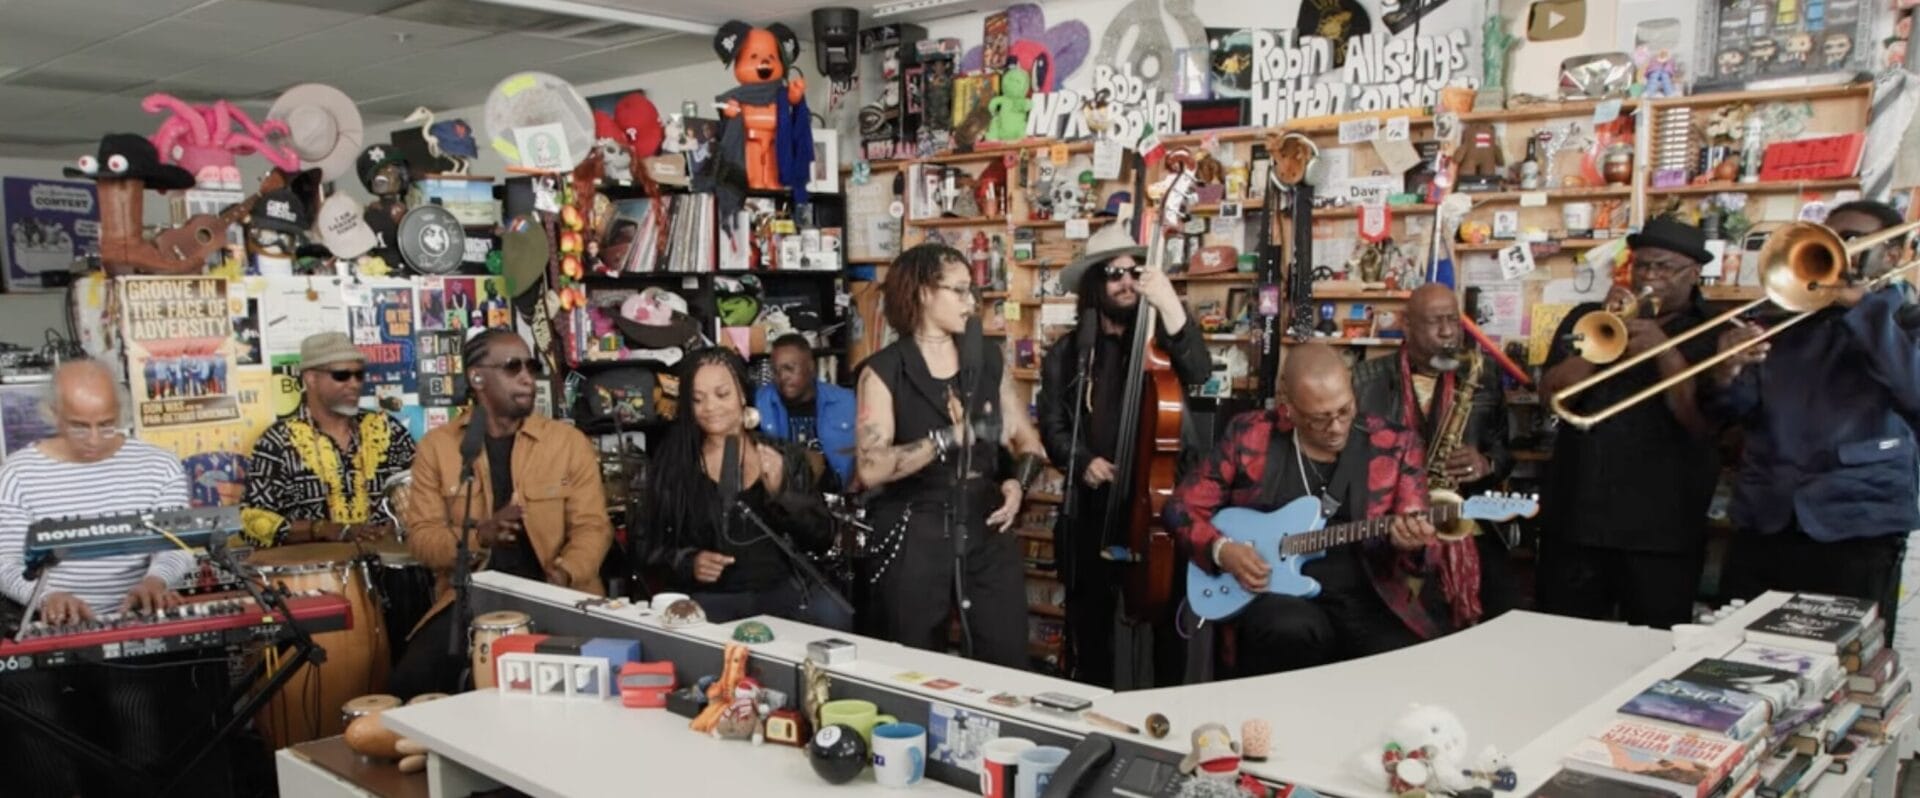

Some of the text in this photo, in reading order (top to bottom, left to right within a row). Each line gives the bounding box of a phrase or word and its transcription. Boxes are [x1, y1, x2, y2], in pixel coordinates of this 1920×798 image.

[1252, 29, 1330, 82] Robin
[1096, 63, 1142, 104] Bob
[1252, 78, 1346, 127] Hilton
[128, 280, 217, 299] GROOVE IN
[131, 299, 227, 319] THE FACE OF
[134, 318, 227, 339] ADVERSITY
[37, 523, 132, 542] novation
